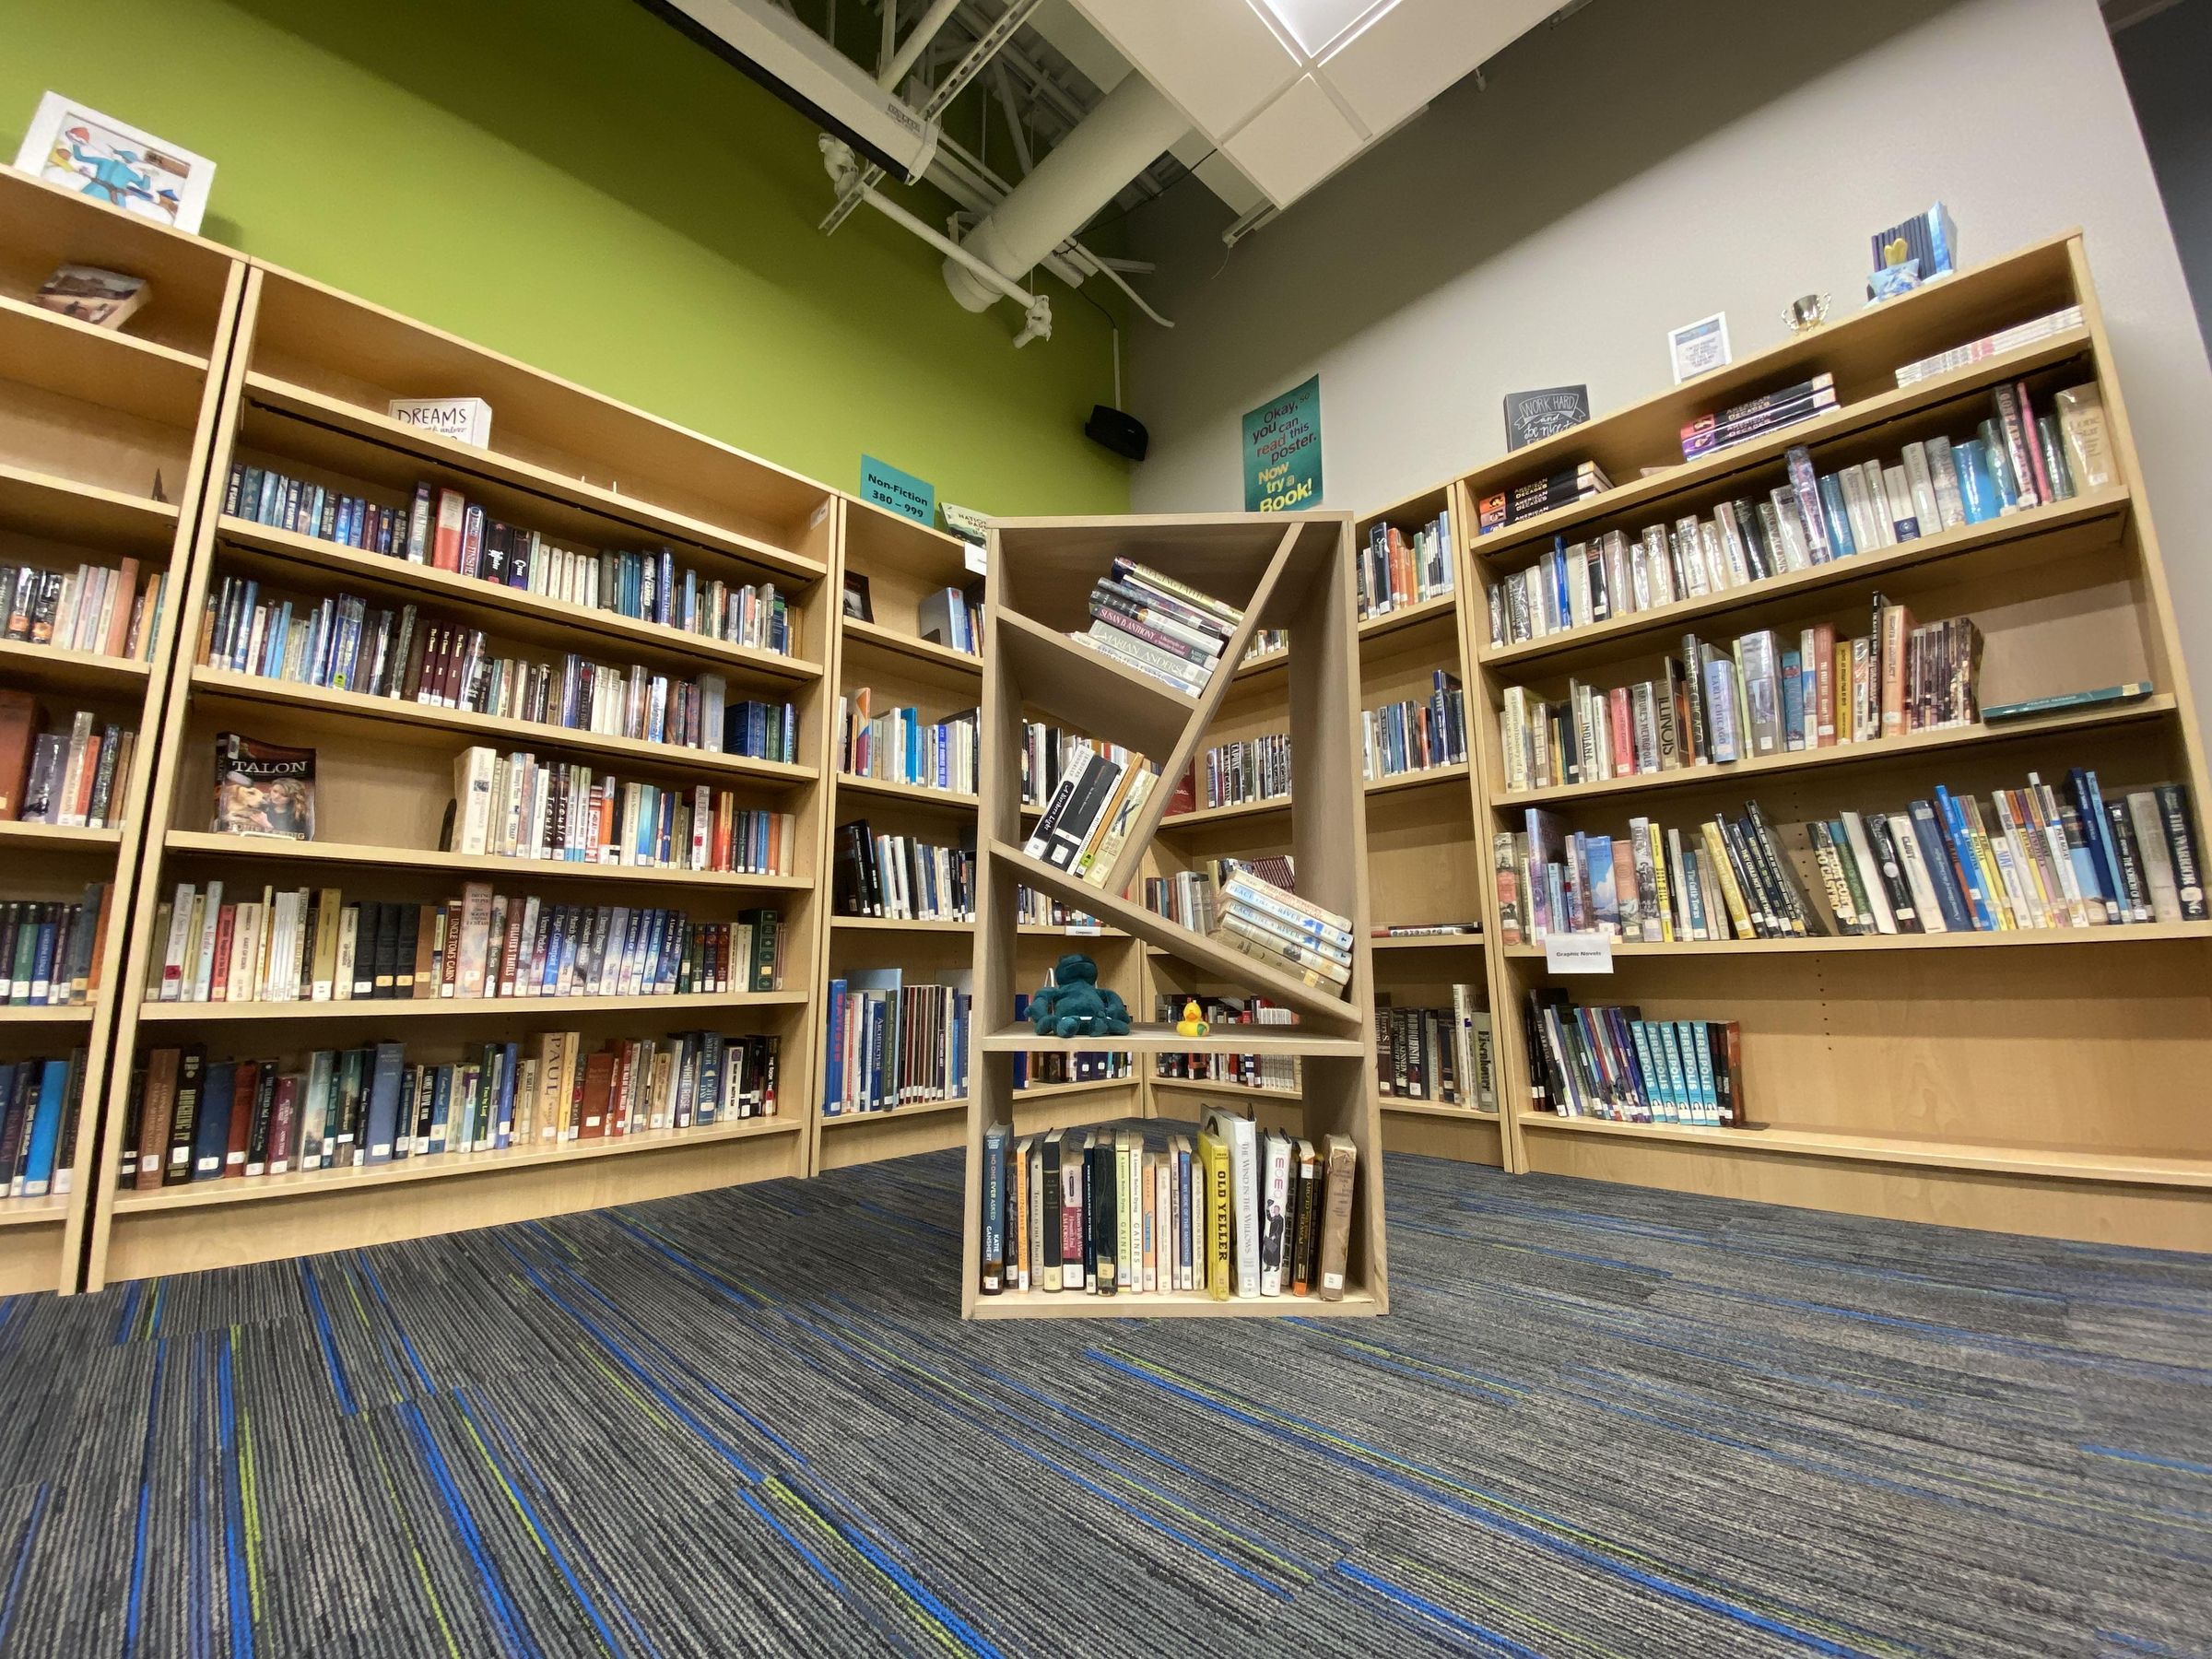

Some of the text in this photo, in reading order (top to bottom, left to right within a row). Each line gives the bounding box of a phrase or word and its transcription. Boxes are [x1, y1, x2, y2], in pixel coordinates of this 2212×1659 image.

[397, 407, 466, 425] DREAMS
[1264, 392, 1310, 424] Okay, so
[1523, 395, 1575, 417] WORK HARD
[1535, 413, 1560, 424] and
[1253, 417, 1299, 445] you can
[1256, 422, 1310, 457] read this
[1524, 423, 1539, 440] be
[1272, 432, 1317, 465] poster.
[868, 473, 928, 506] Non-Fiction
[1258, 462, 1289, 485] Now
[1266, 475, 1295, 494] try a
[1514, 477, 1548, 494] AMERICAN
[872, 490, 924, 517] 380 999
[1260, 478, 1312, 512] Book!
[1514, 490, 1548, 507] AMERICAN
[1516, 483, 1547, 499] DECADES
[1516, 496, 1547, 512] DECADES
[1514, 506, 1549, 522] AMERICAN
[1100, 608, 1158, 641] SUSAN ANTHONY
[1105, 633, 1139, 655] MARIAN
[1658, 696, 1675, 756] ILLINOIS
[1692, 693, 1703, 743] CHICAGO
[1712, 675, 1726, 745] EARLY CHICAGO
[1583, 723, 1594, 760] INDIANA
[232, 761, 307, 773] TALON
[545, 796, 555, 841] Trouble
[557, 796, 569, 841] Trouble
[1044, 815, 1057, 830] Light
[2173, 835, 2196, 886] WARRIOR
[298, 890, 308, 925] STEINBECK
[1229, 902, 1300, 939] PEACE RIVER
[1230, 885, 1300, 922] PEACE RIVER
[536, 916, 548, 954] Vienna Prelude
[548, 914, 565, 966] Prague Counterpoint
[564, 915, 578, 959] Munich Signature
[582, 917, 594, 942] Jerusalem
[594, 935, 605, 955] Passage
[445, 918, 459, 981] UNCLE TOM'S CABIN
[505, 924, 521, 977] GULLIVER'S TRAVELS
[544, 1037, 562, 1095] PAUL
[1478, 1030, 1490, 1091] Eisenhower
[1633, 1026, 1655, 1088] PERSEPOLIS
[1648, 1027, 1668, 1089] PERSEPOLIS
[1662, 1027, 1683, 1090] PERSEPOLIS
[1679, 1026, 1698, 1090] PERSEPOLIS
[1695, 1027, 1712, 1091] PERSEPOLIS
[680, 1065, 693, 1109] WHITE ROSE
[173, 1089, 197, 1141] ROUGHING IT
[990, 1154, 996, 1165] NO
[1241, 1159, 1250, 1181] WIND
[1242, 1183, 1250, 1193] IN
[1183, 1208, 1188, 1217] OF
[1218, 1171, 1228, 1262] OLD YELLER
[1243, 1213, 1253, 1254] WILLOWS
